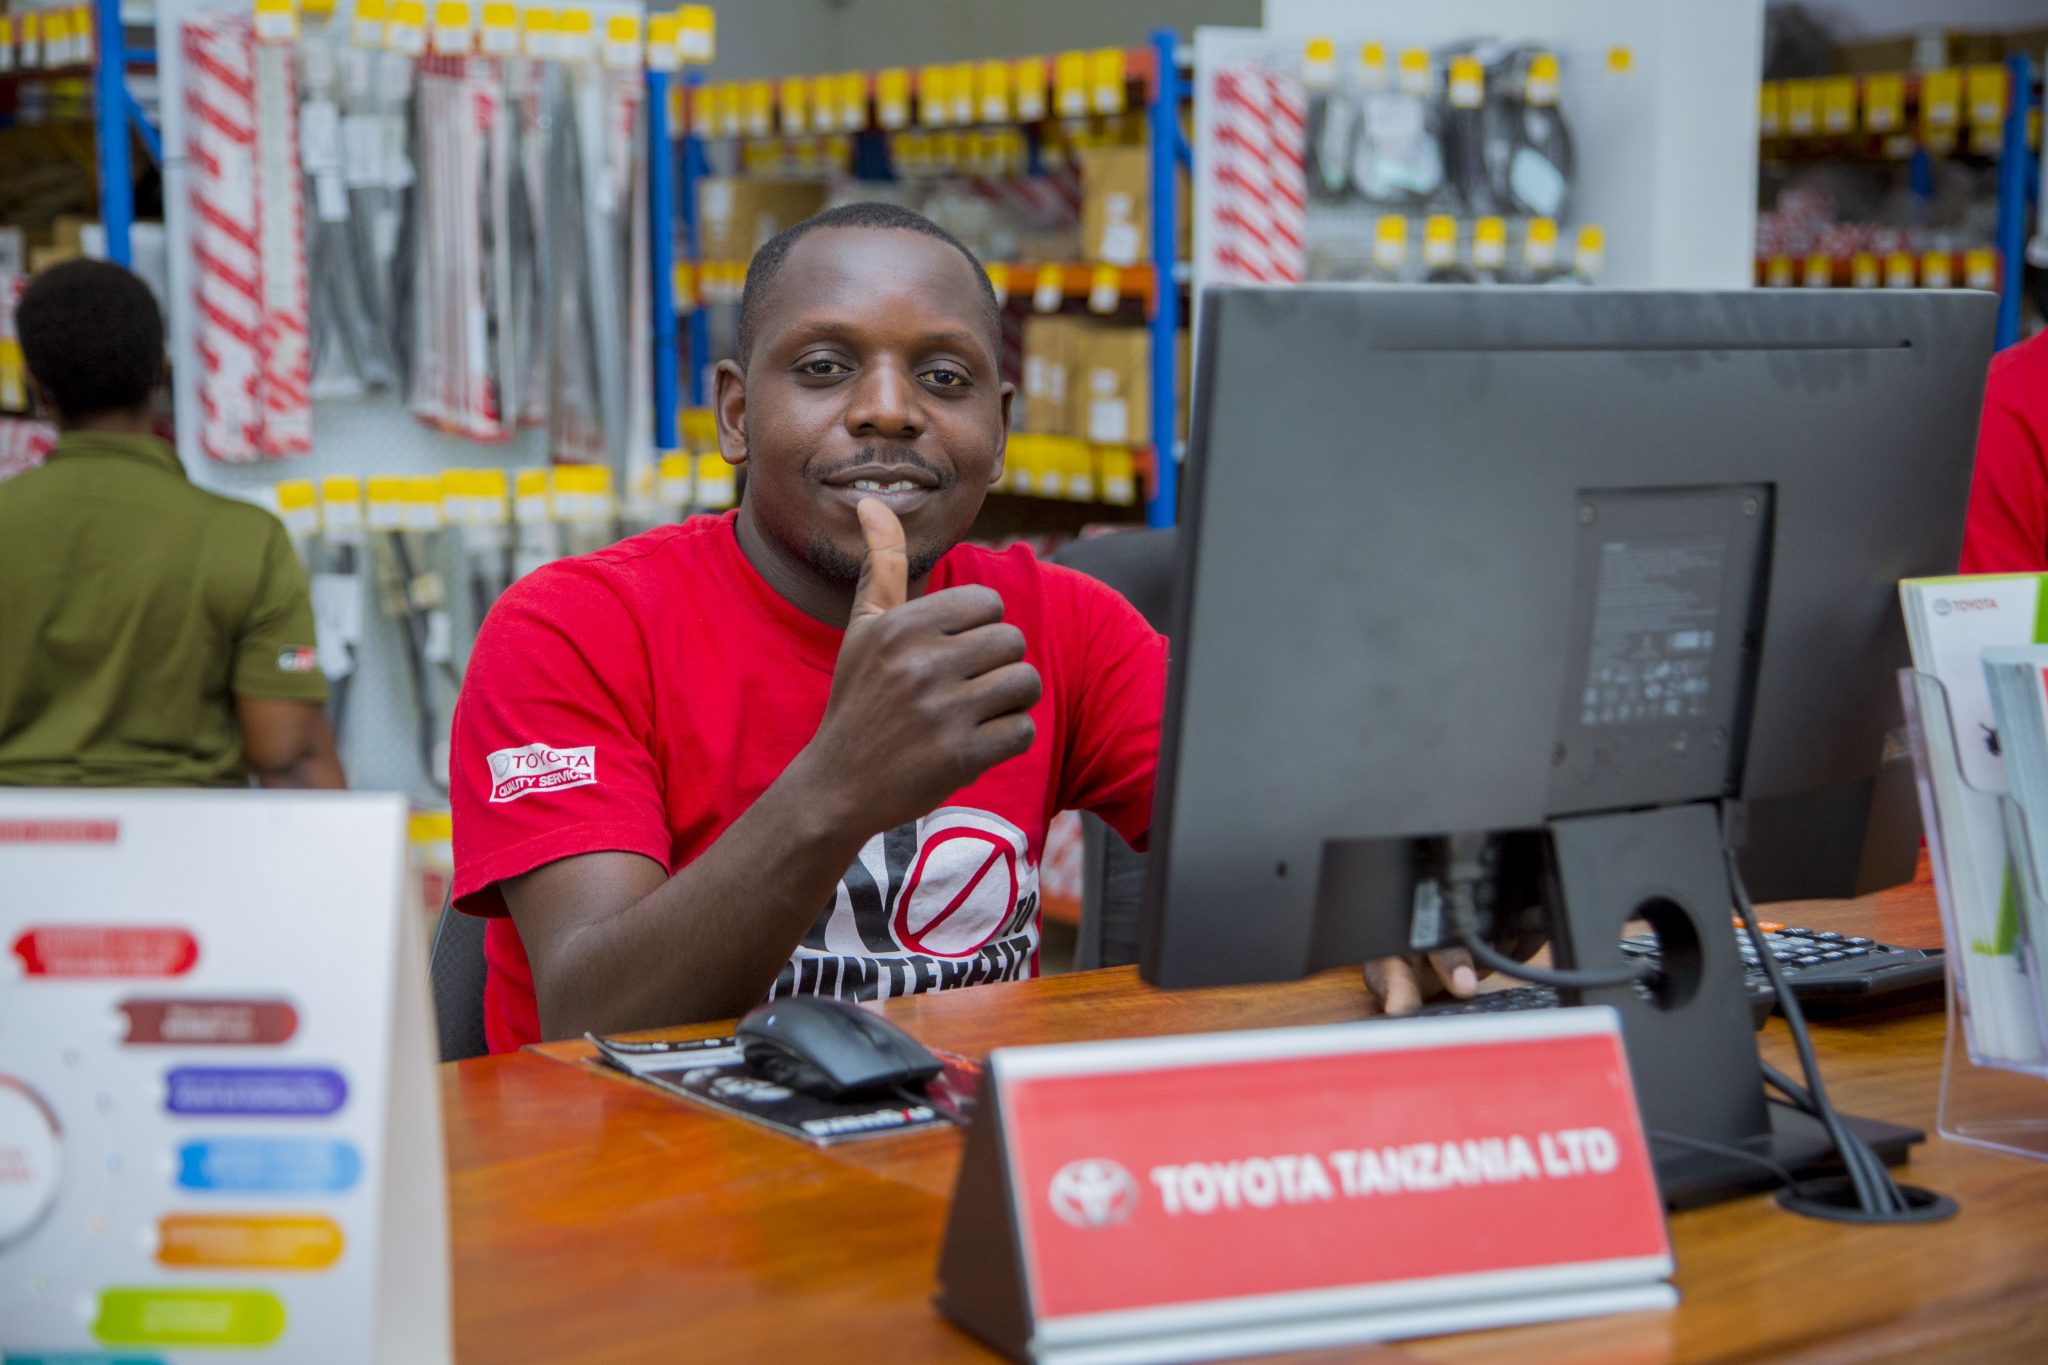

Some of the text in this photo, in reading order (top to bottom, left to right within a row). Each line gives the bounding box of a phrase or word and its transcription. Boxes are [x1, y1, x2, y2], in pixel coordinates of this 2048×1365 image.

[1952, 598, 1999, 611] TOYOTA
[512, 750, 590, 768] TOYOTA
[499, 777, 536, 797] QUALITY
[1002, 891, 1037, 937] TO
[771, 935, 1032, 1001] UNTERFEIT
[1151, 1127, 1619, 1215] TOYOTA TANZANIA LTD
